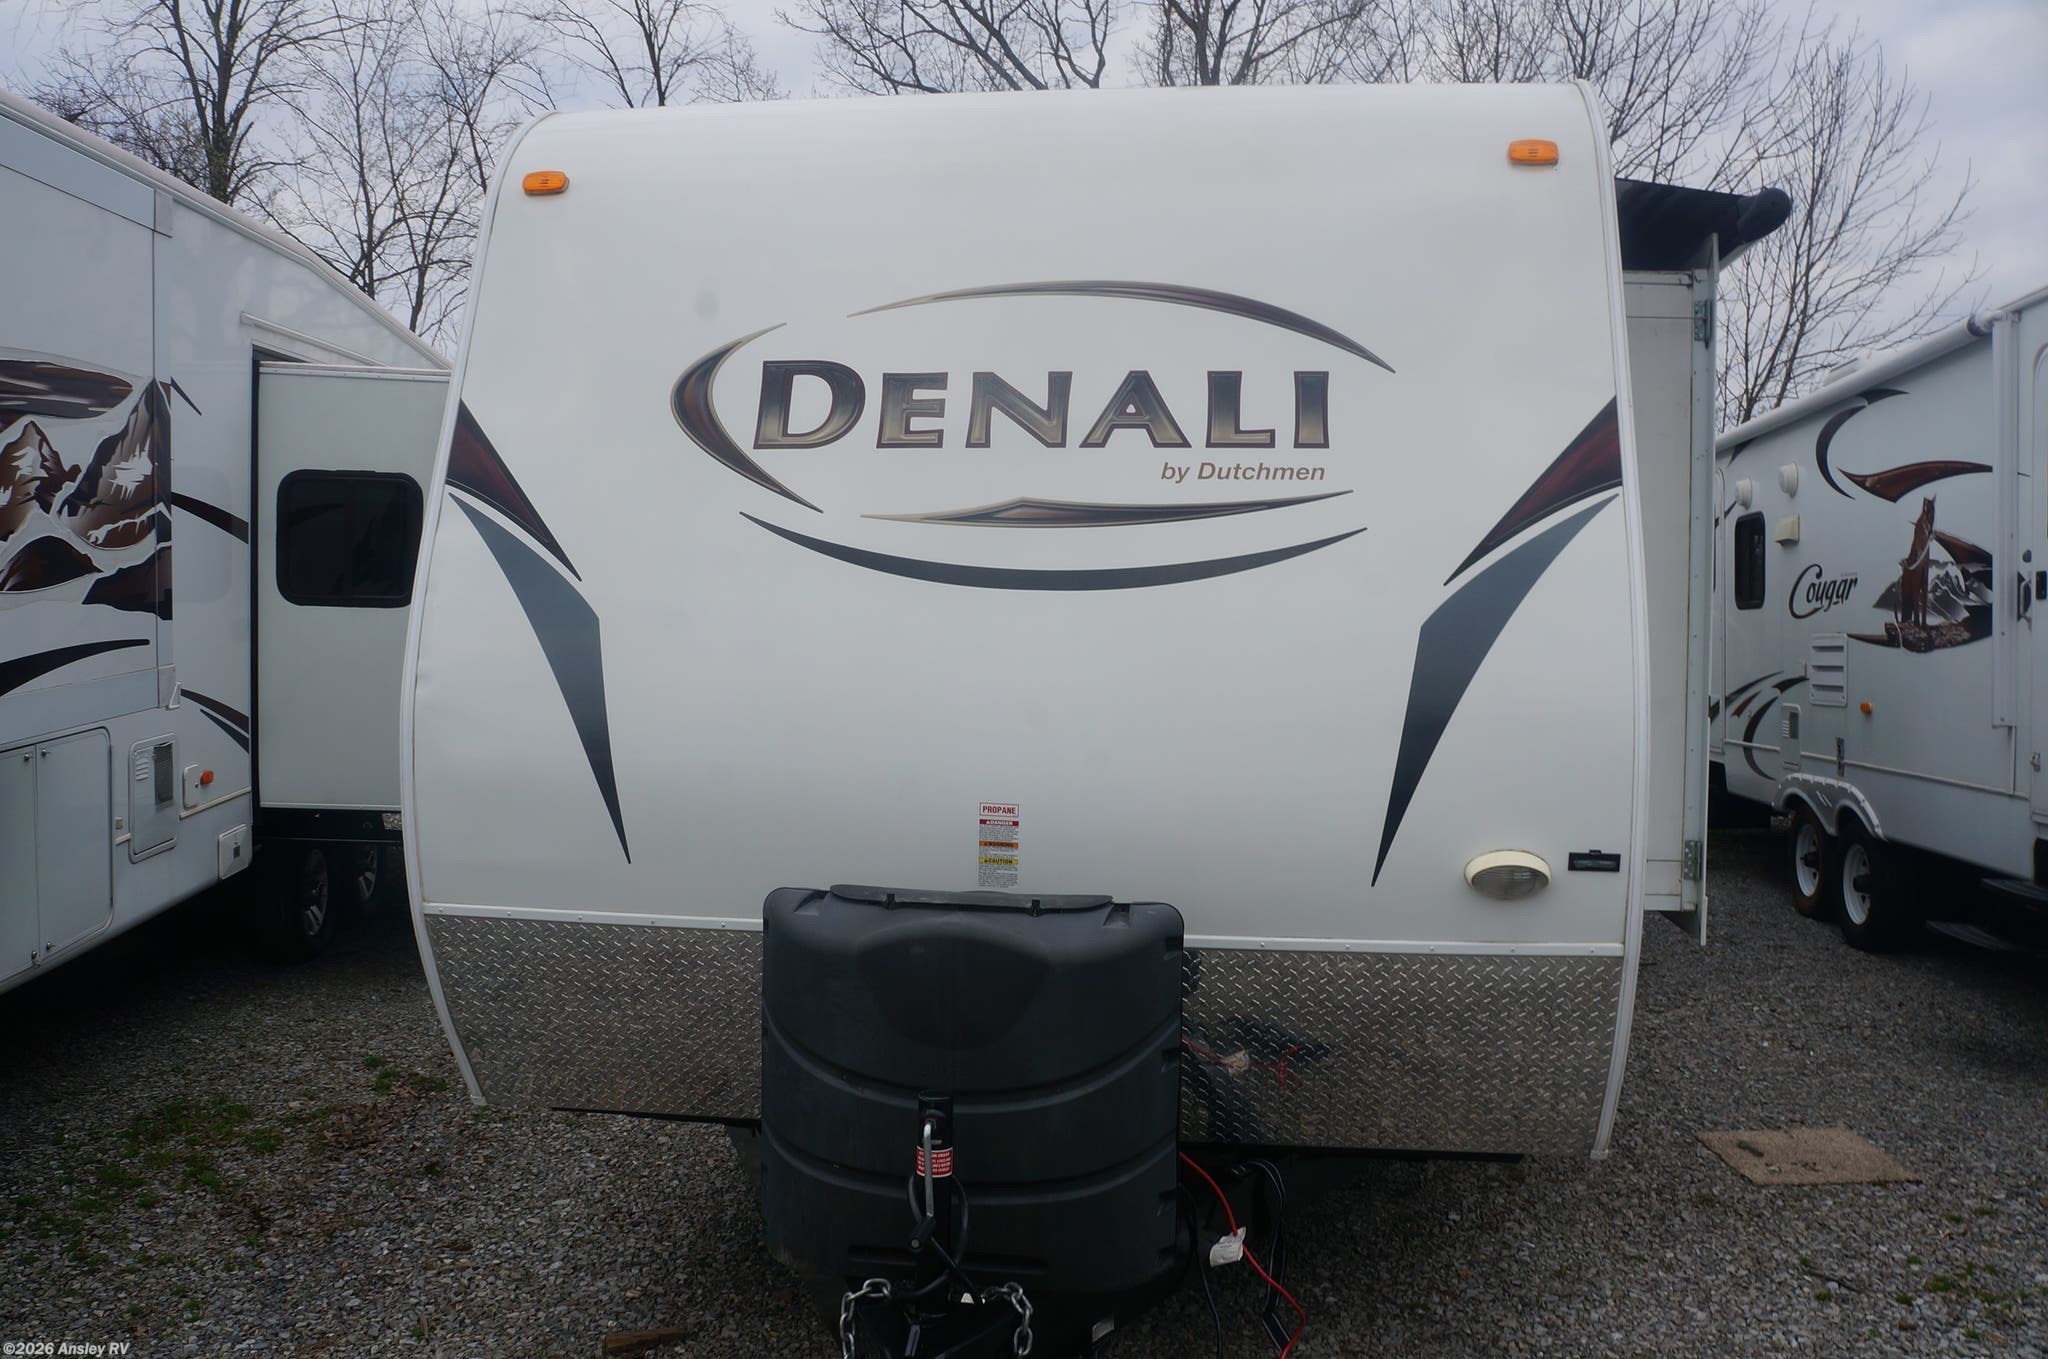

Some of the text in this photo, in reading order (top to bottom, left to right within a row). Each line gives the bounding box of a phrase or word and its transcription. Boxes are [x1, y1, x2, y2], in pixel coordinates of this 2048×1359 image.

[753, 359, 1330, 449] DENALI
[1160, 461, 1326, 484] by Dutchmen
[1788, 563, 1858, 619] Cougar
[982, 805, 1016, 815] PROPANE
